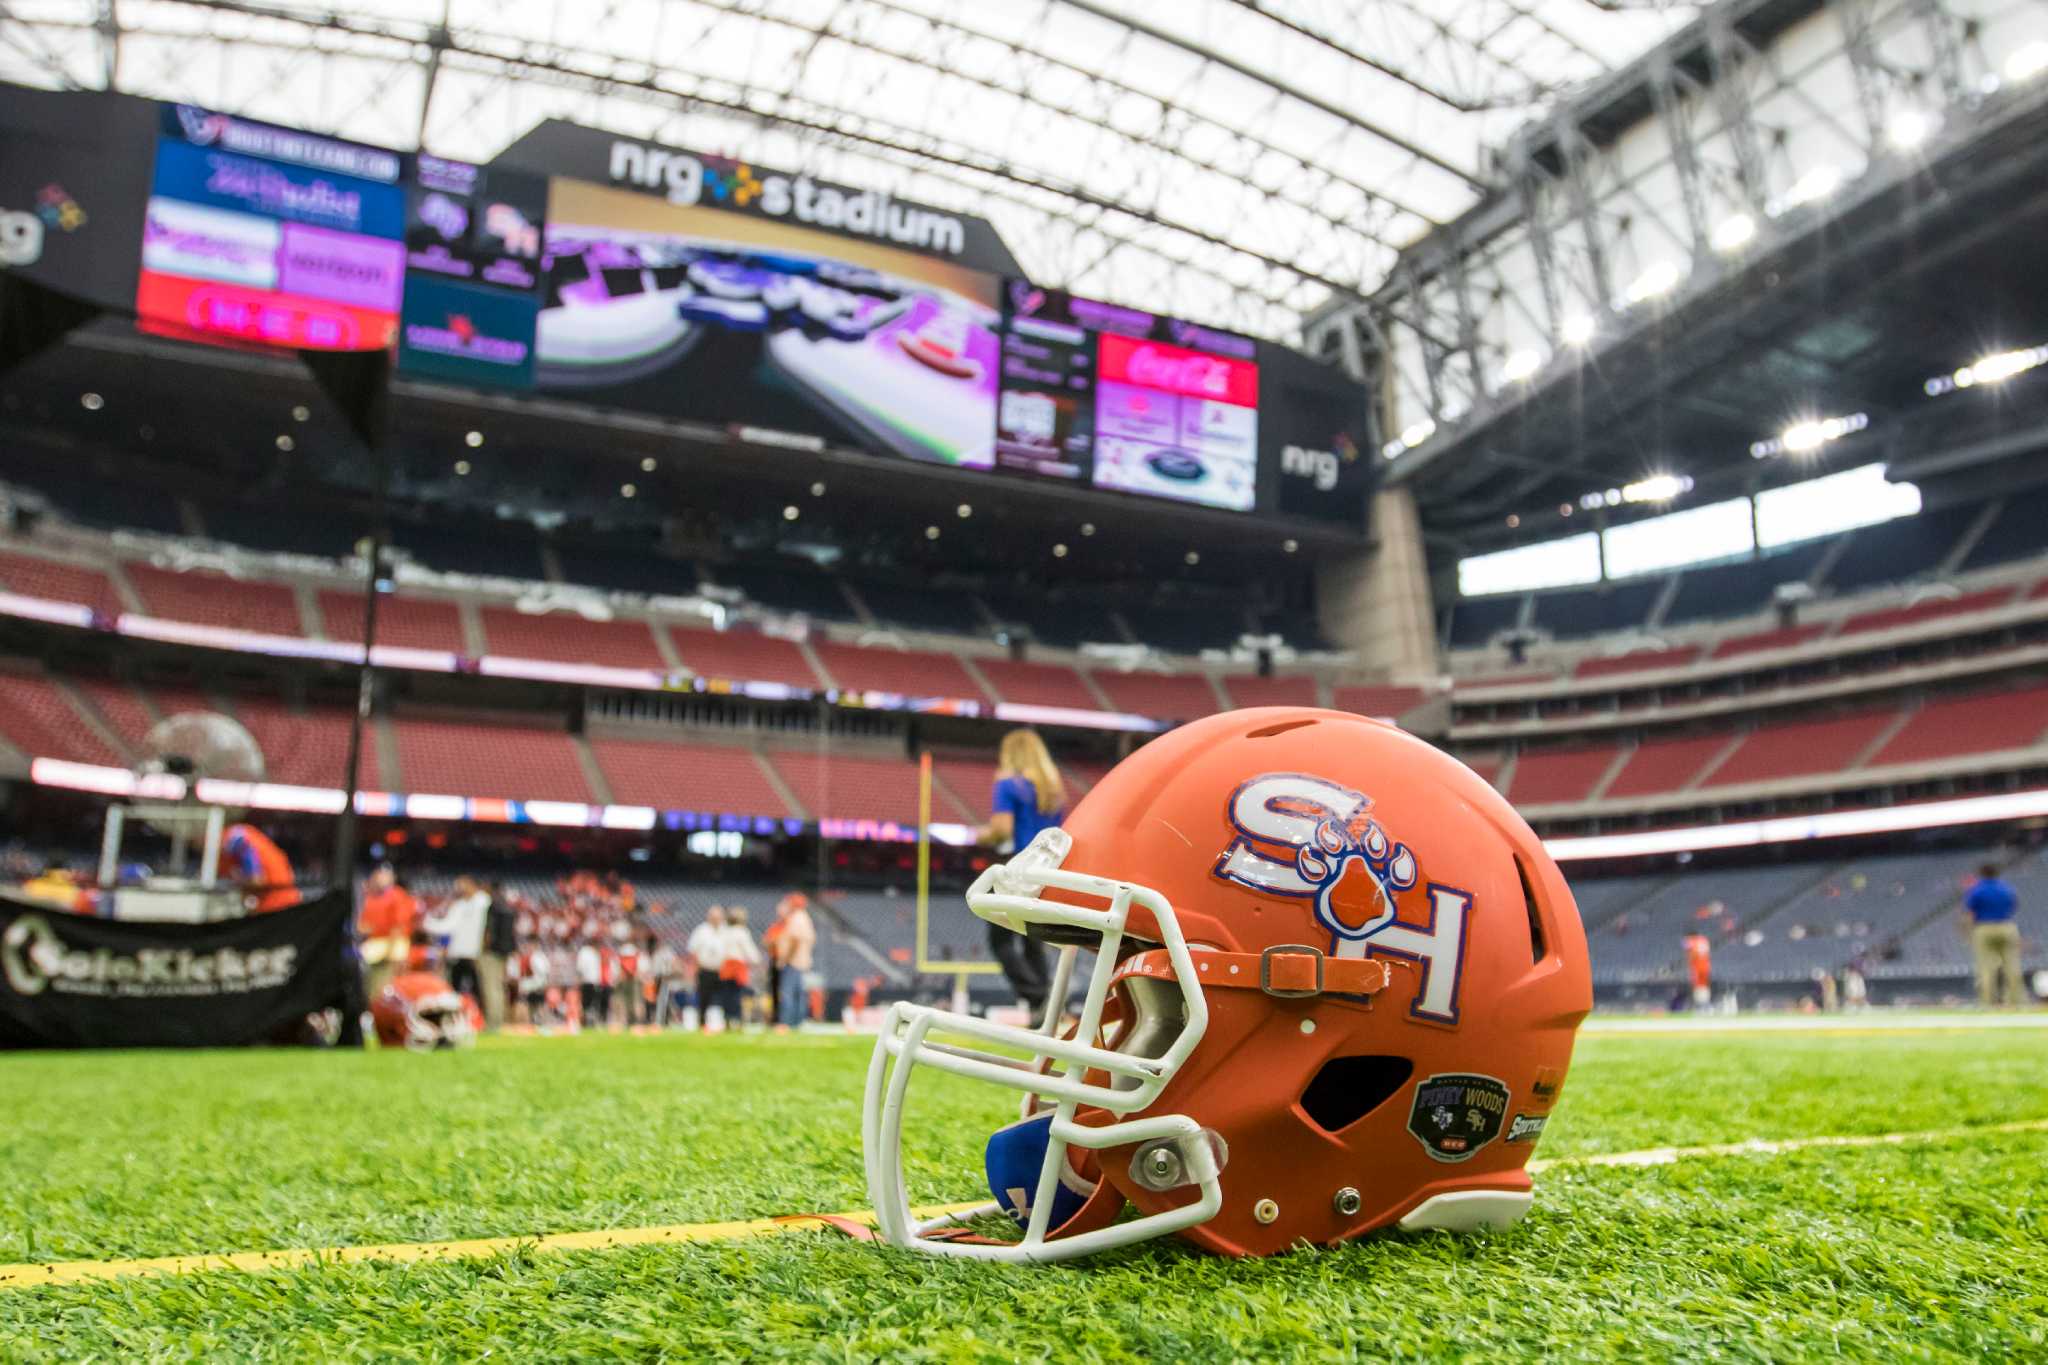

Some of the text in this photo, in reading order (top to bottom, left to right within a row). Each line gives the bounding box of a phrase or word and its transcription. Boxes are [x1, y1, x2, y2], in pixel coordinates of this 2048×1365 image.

[609, 140, 964, 254] nrg stadium
[0, 206, 44, 267] g
[1281, 444, 1339, 491] nrg
[1466, 1088, 1504, 1114] WOODS
